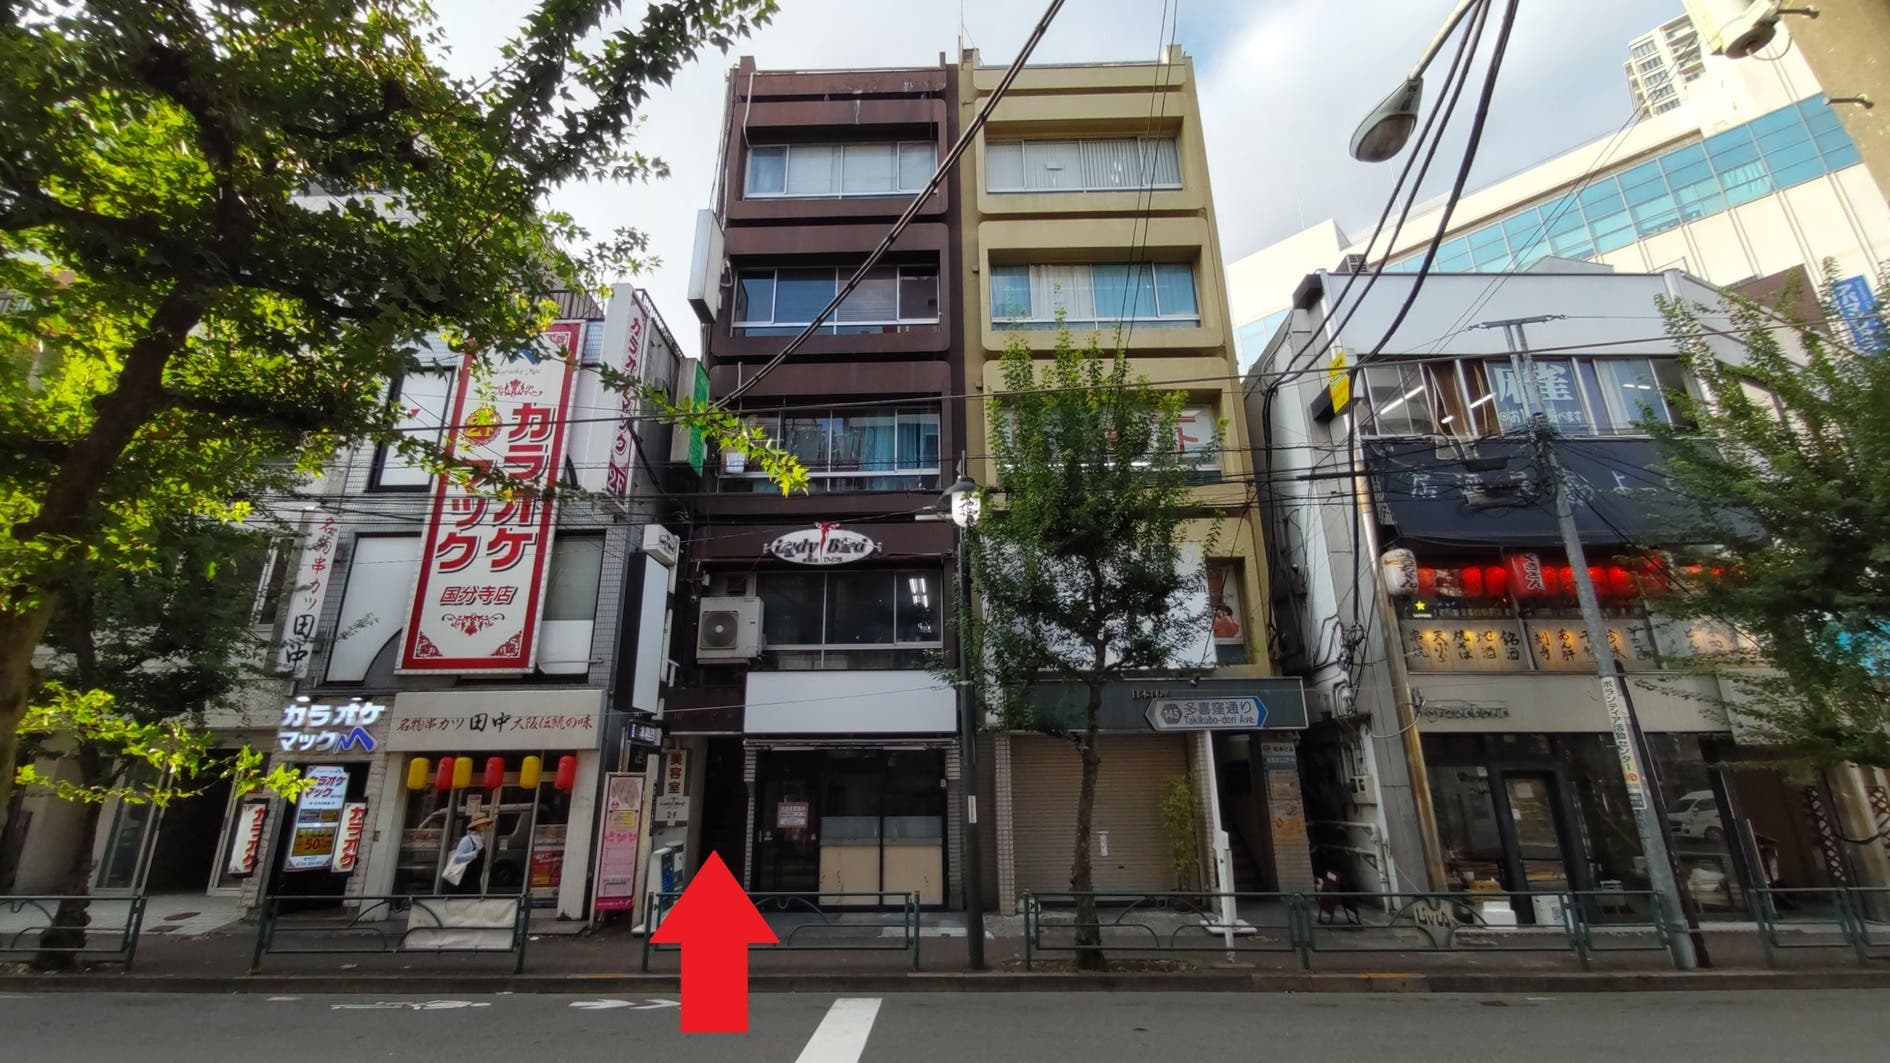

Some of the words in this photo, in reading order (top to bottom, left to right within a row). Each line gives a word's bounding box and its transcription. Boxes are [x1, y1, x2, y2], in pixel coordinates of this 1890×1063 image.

[487, 402, 556, 572] カラオケ
[435, 459, 498, 573] マック
[304, 516, 338, 611] 名物串カツ
[440, 585, 518, 605] 国分寺店
[286, 614, 315, 672] 田中
[1432, 630, 1448, 663] 天ぷら
[1476, 630, 1497, 660] 地酒
[1501, 629, 1520, 661] 銘酒
[281, 701, 386, 727] カラオケ
[399, 717, 465, 732] 名物串カツ
[469, 712, 513, 732] 田中
[510, 714, 594, 731] 大阪伝統の味
[1164, 710, 1179, 720] 145
[1184, 701, 1252, 715] 多喜窪通り
[278, 731, 337, 752] マック
[668, 752, 683, 794] 美容室
[242, 807, 268, 869] カラオケ
[340, 806, 365, 868] カラオケ
